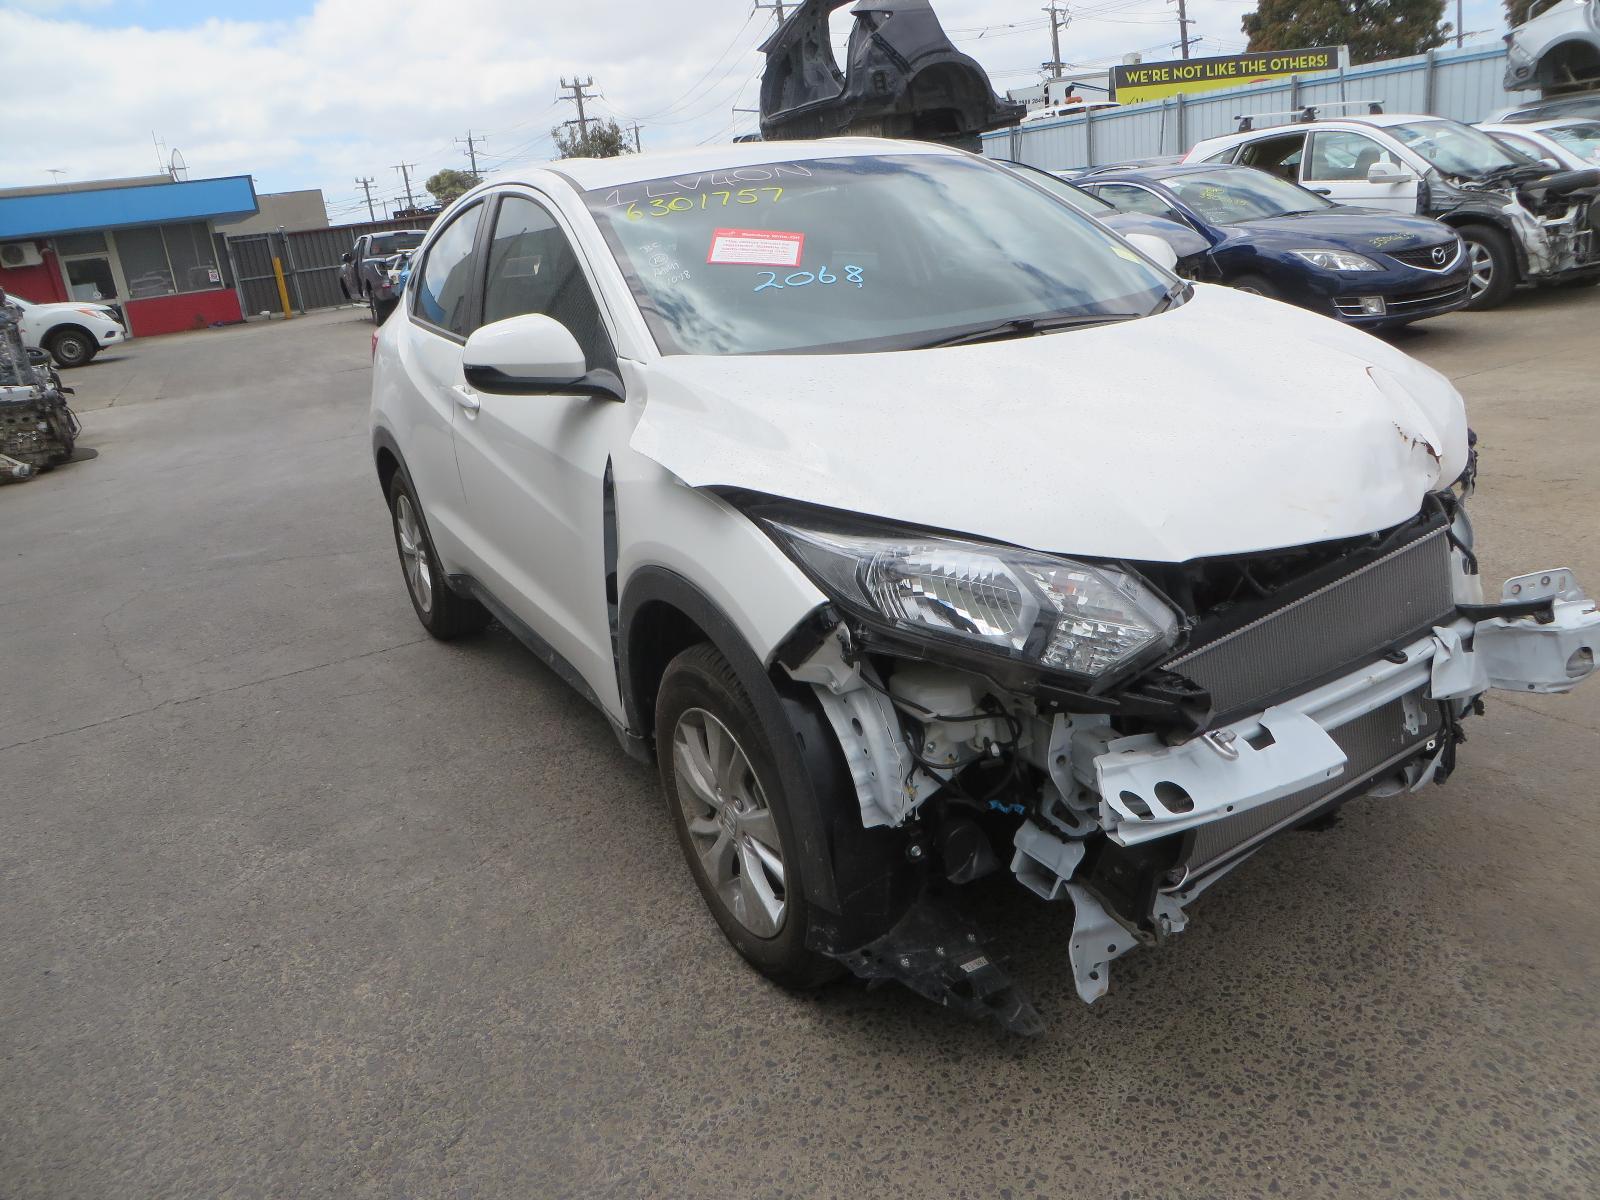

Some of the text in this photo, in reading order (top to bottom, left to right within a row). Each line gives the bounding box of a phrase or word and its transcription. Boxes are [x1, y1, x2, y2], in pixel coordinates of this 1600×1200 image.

[1126, 54, 1329, 84] WE'RE NOT LIKE THE OTHERS!
[626, 186, 784, 221] 6301757
[753, 265, 864, 292] 2068
